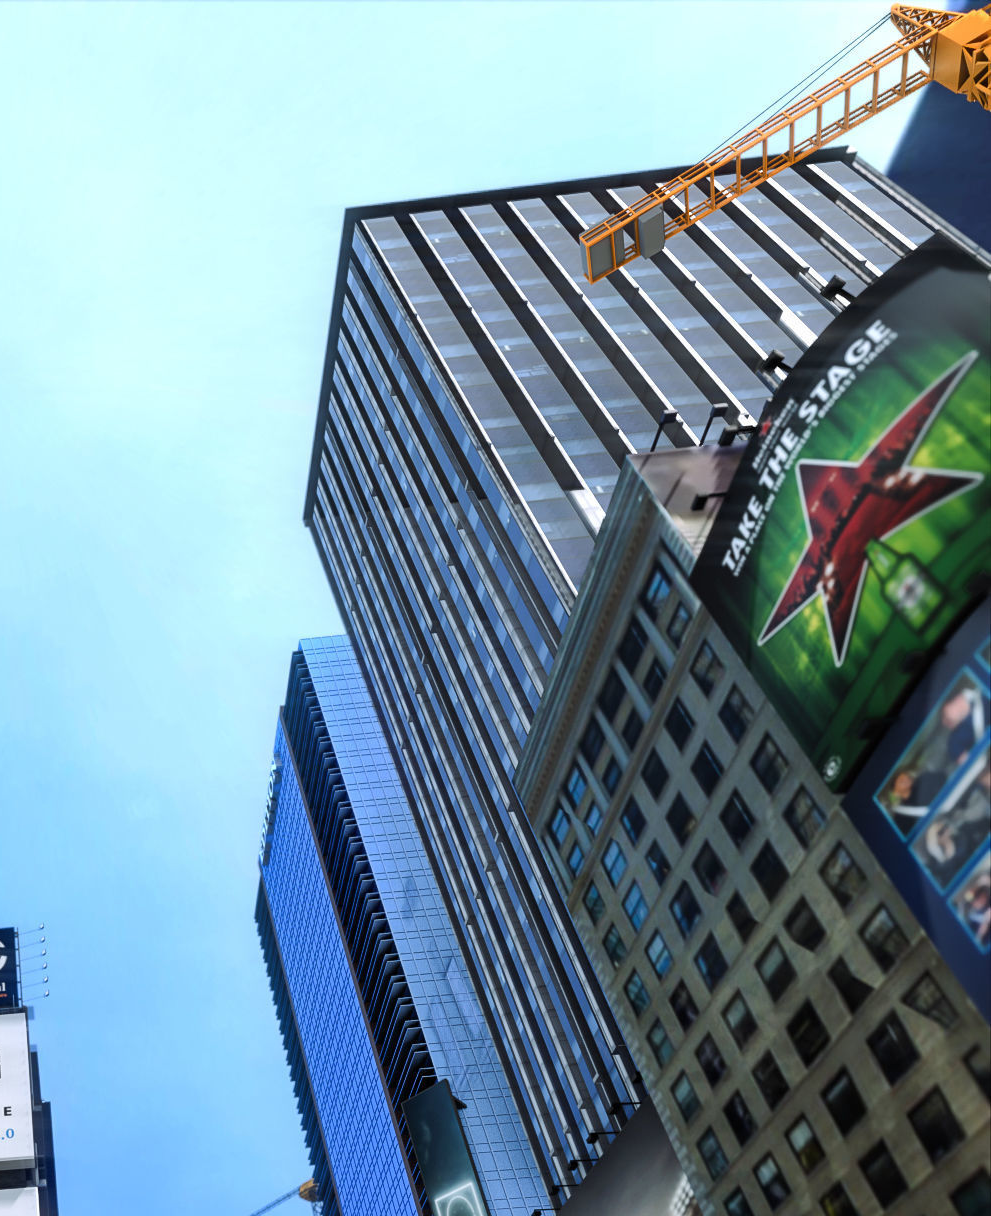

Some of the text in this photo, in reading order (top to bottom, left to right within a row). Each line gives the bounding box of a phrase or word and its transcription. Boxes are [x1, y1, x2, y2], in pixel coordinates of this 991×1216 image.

[721, 495, 764, 571] TAKE
[759, 427, 799, 490] THE
[798, 320, 891, 423] STAGE
